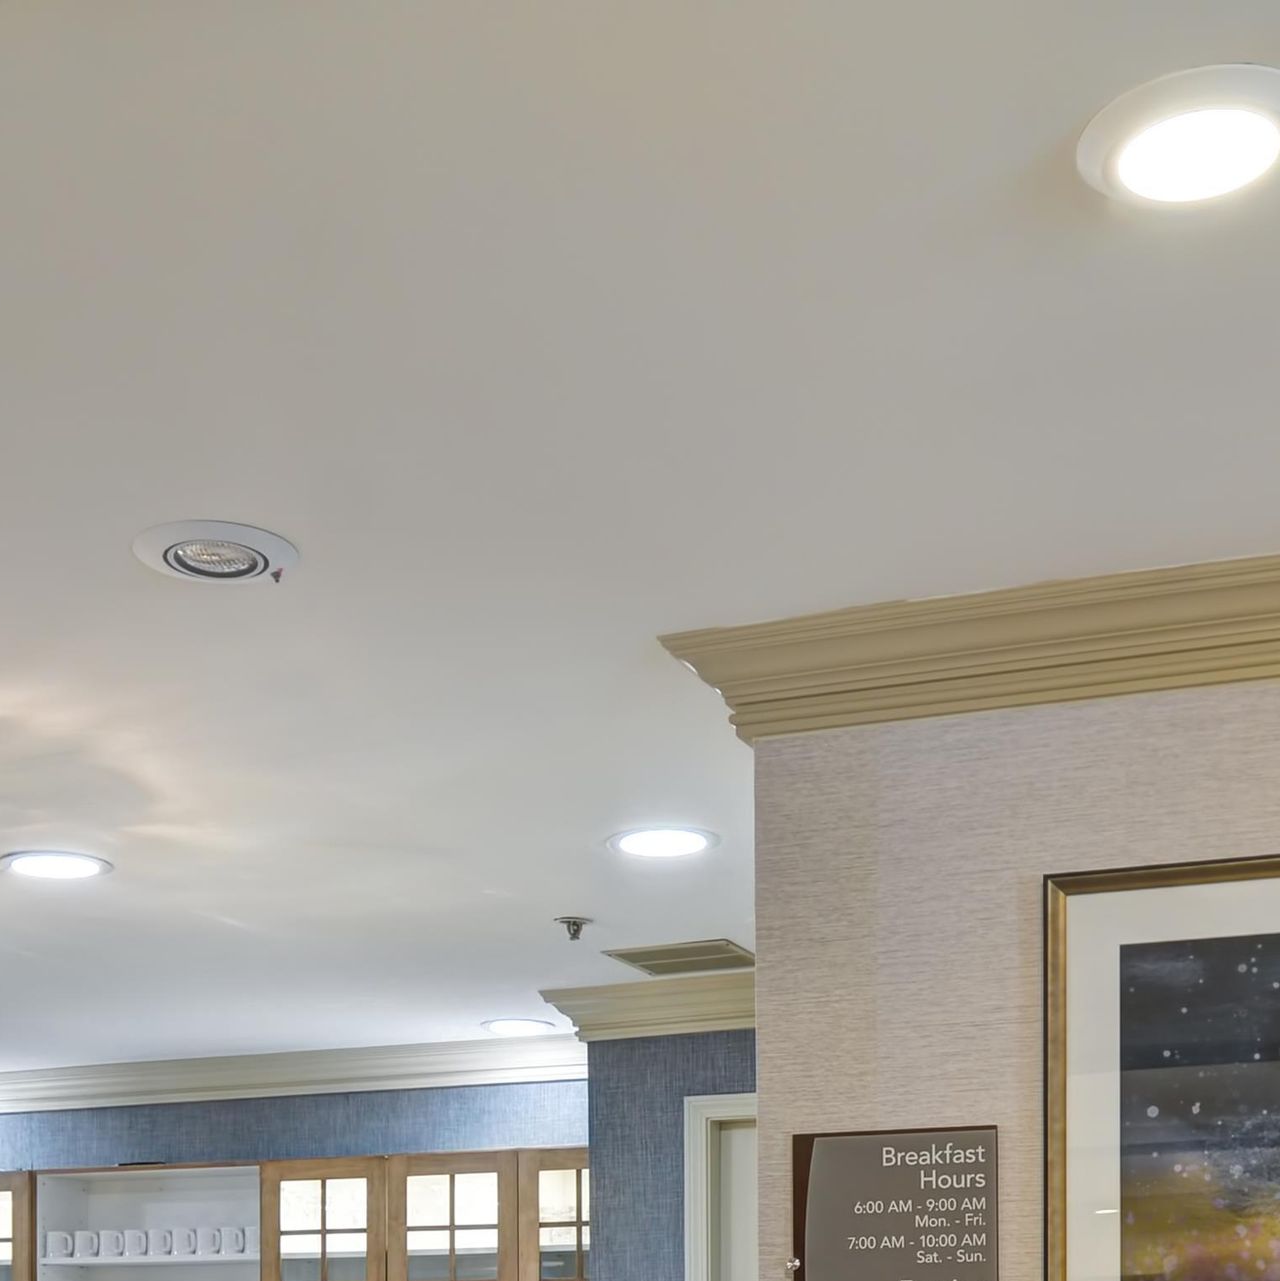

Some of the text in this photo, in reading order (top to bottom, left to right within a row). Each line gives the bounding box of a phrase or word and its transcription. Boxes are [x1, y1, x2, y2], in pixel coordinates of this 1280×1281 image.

[882, 1143, 986, 1166] Breakfast
[920, 1170, 986, 1189] Hours
[854, 1201, 884, 1213] 6:00
[887, 1200, 913, 1212] AM
[925, 1198, 957, 1211] 9:00
[960, 1197, 986, 1210] AM
[915, 1215, 951, 1227] Mon.
[965, 1213, 986, 1225] Fri.
[847, 1237, 877, 1249] 7:00
[879, 1236, 905, 1248] AM
[919, 1234, 957, 1247] 10:00
[960, 1234, 986, 1246] AM
[916, 1251, 943, 1263] Sat.
[956, 1250, 987, 1262] Sun.
